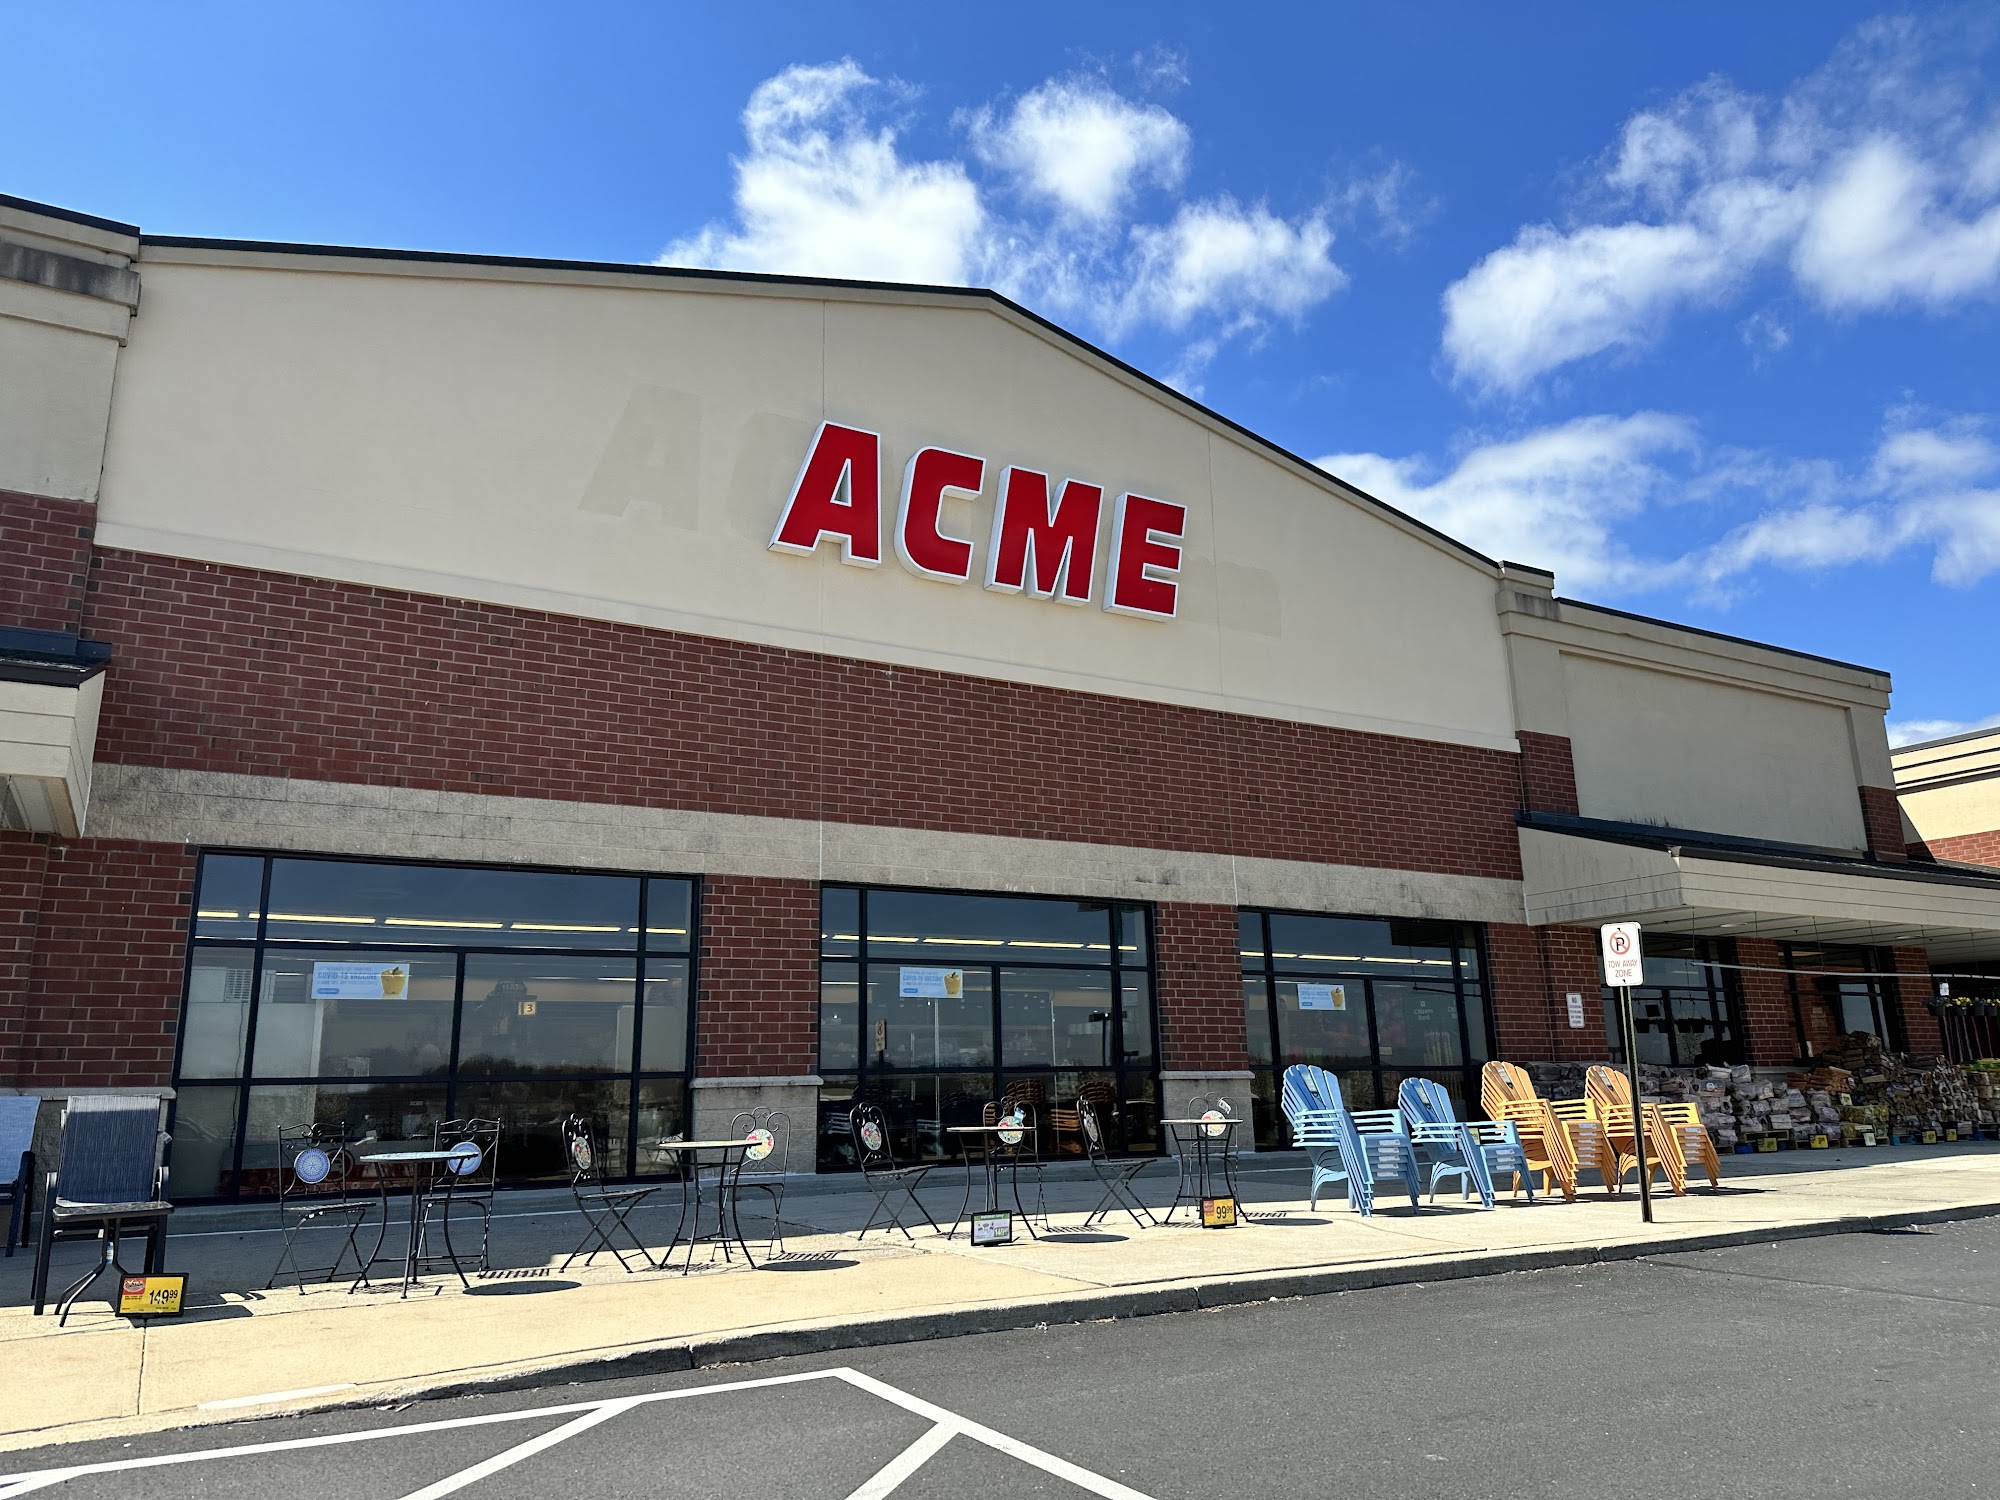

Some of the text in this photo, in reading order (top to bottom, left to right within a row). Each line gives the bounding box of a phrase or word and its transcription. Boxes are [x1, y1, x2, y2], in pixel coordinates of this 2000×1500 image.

[767, 420, 1187, 623] ACME
[1607, 959, 1638, 969] TOW AWAY
[1615, 969, 1633, 978] ZONE
[526, 1004, 533, 1013] 3
